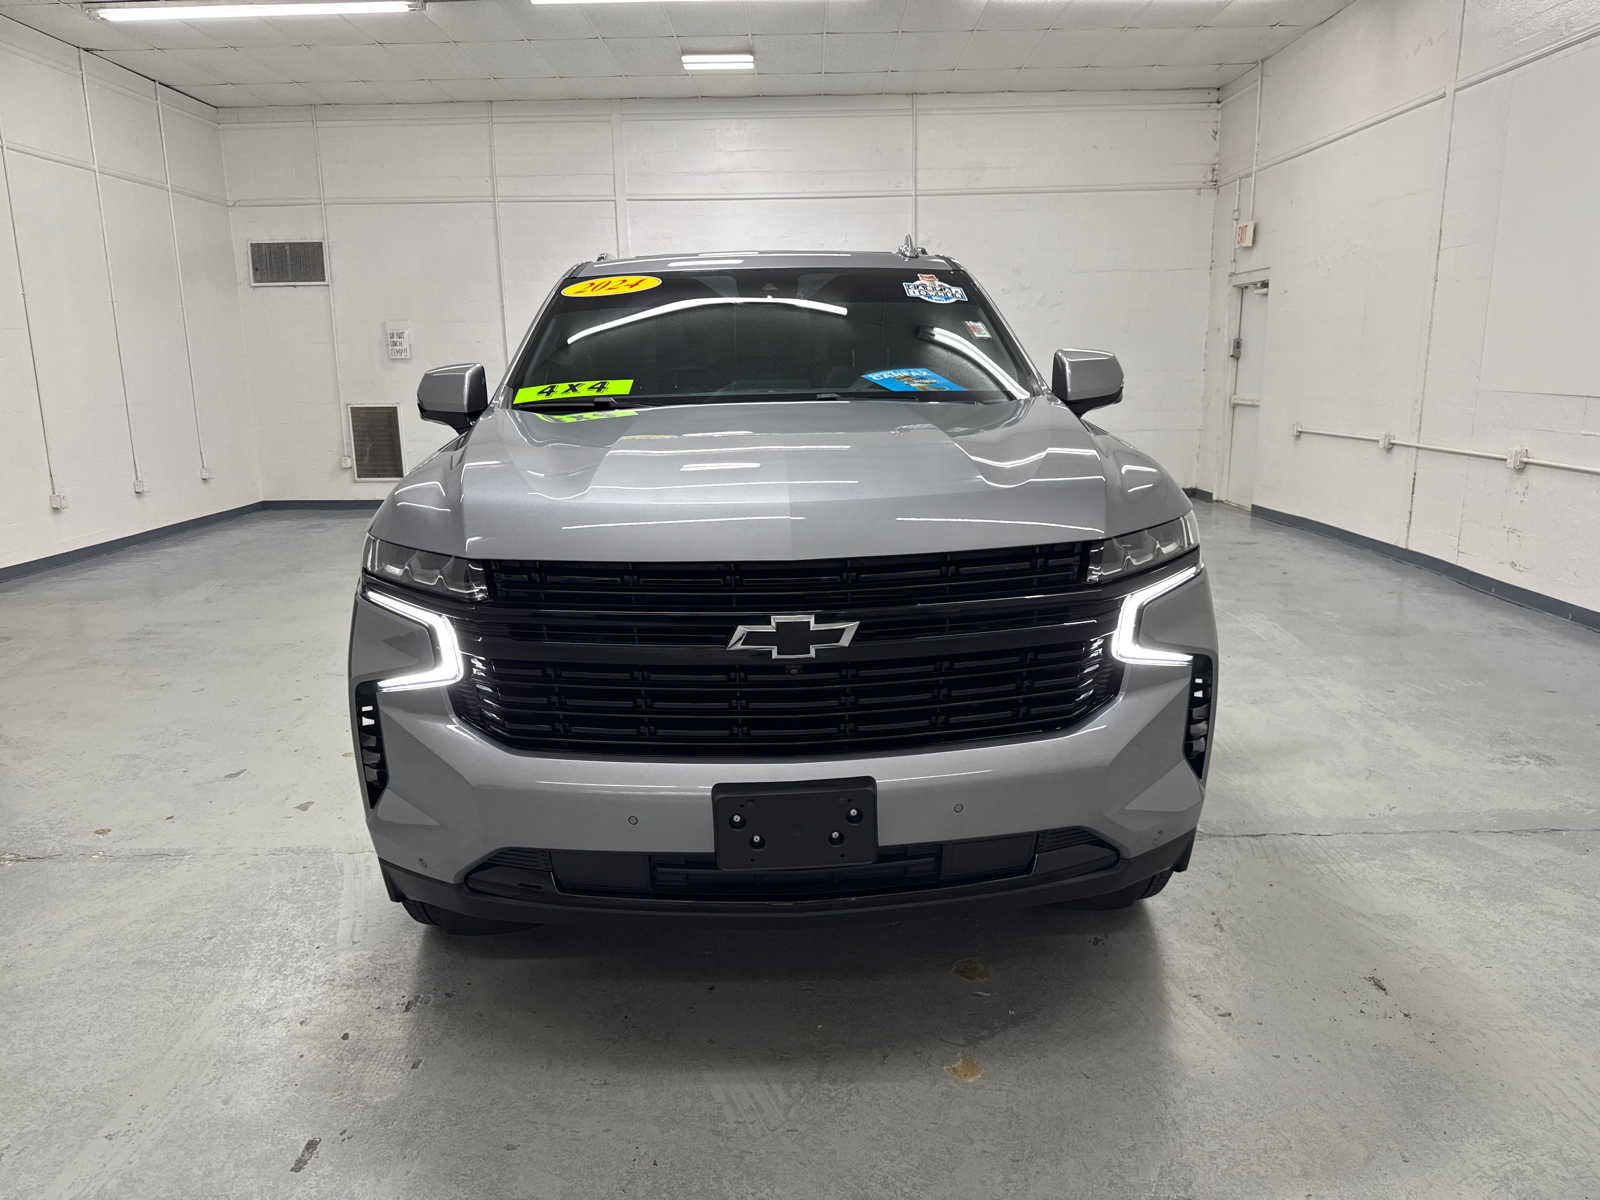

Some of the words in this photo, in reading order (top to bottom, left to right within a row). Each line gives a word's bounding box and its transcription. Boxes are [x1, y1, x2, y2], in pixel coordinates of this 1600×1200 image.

[1237, 224, 1248, 244] EXIT
[572, 277, 648, 294] 2024
[389, 331, 395, 340] DO
[396, 331, 406, 340] NOT
